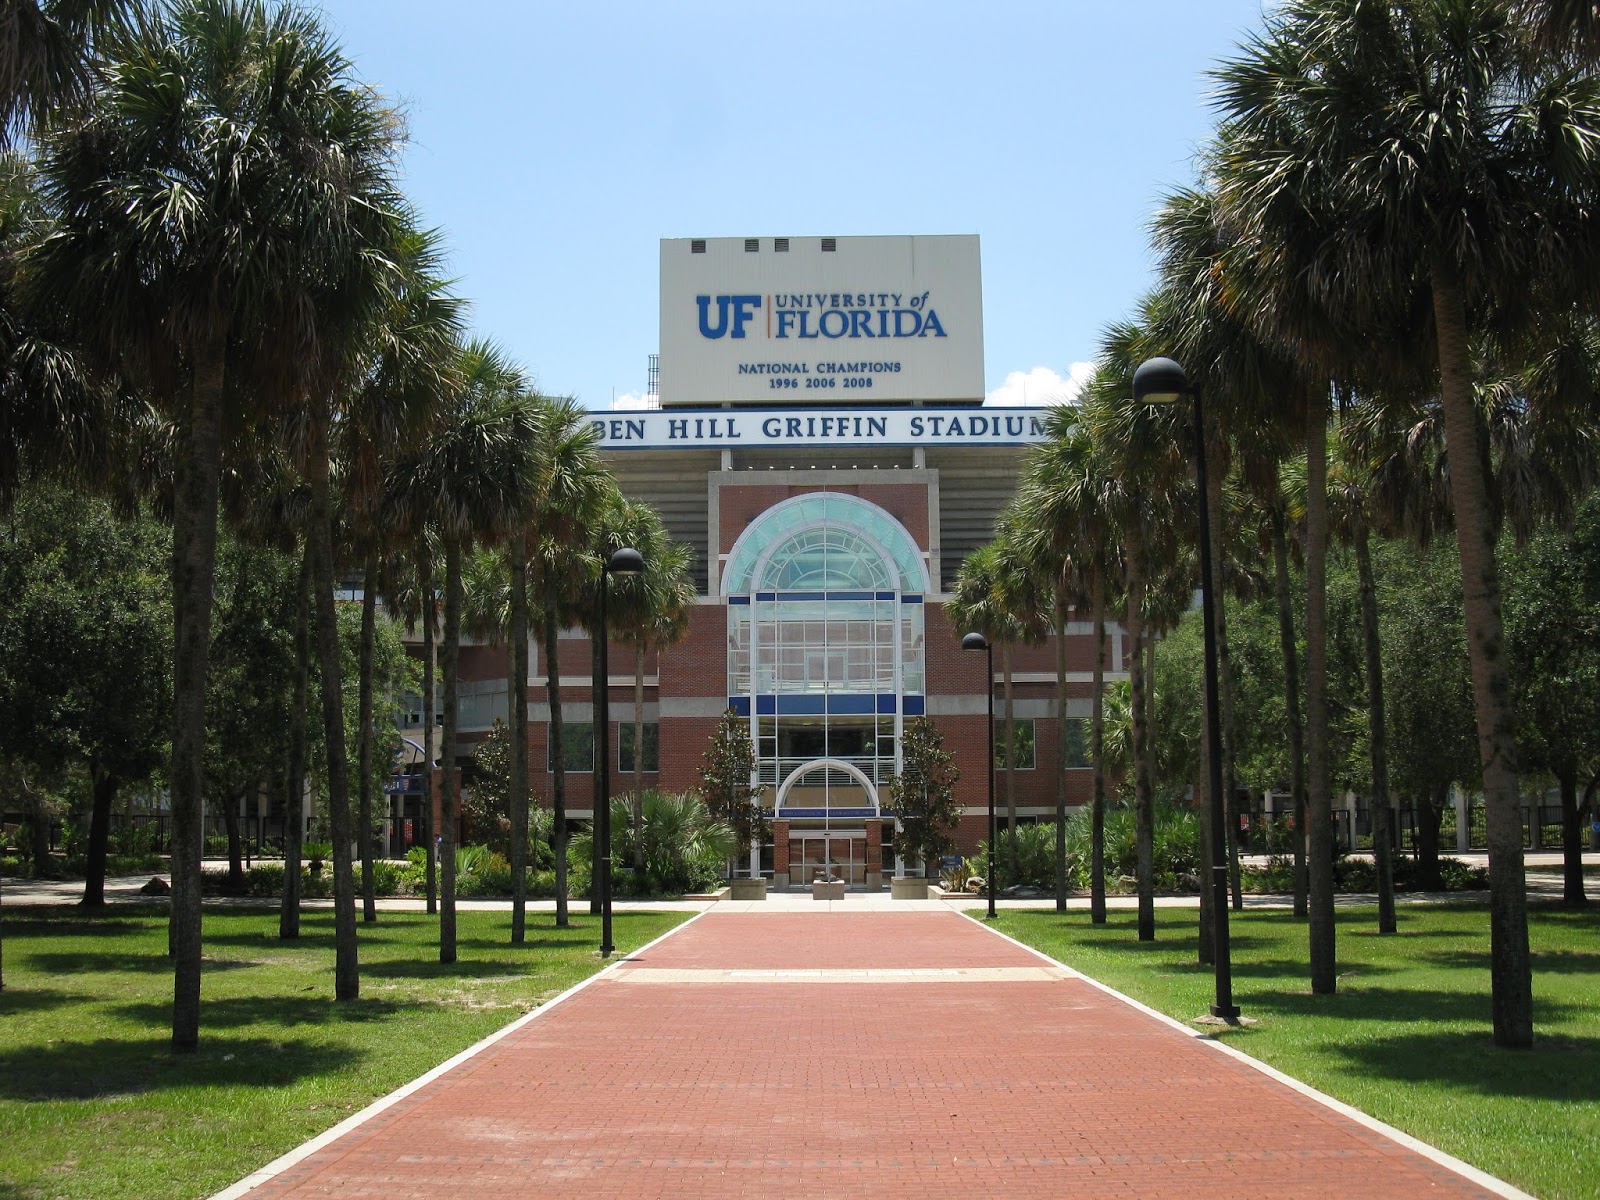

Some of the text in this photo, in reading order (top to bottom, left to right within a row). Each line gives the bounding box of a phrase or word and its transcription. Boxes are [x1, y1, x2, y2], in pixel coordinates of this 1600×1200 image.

[775, 291, 930, 310] UNIVERSITY of
[696, 295, 762, 339] UF
[775, 309, 948, 338] FLORIDA
[738, 362, 902, 374] NATIONAL CHAMPIONS
[769, 378, 873, 389] 1996 2006 2008
[591, 419, 646, 440] BEN
[668, 418, 742, 439] HILL
[762, 417, 888, 438] GRIFFIN
